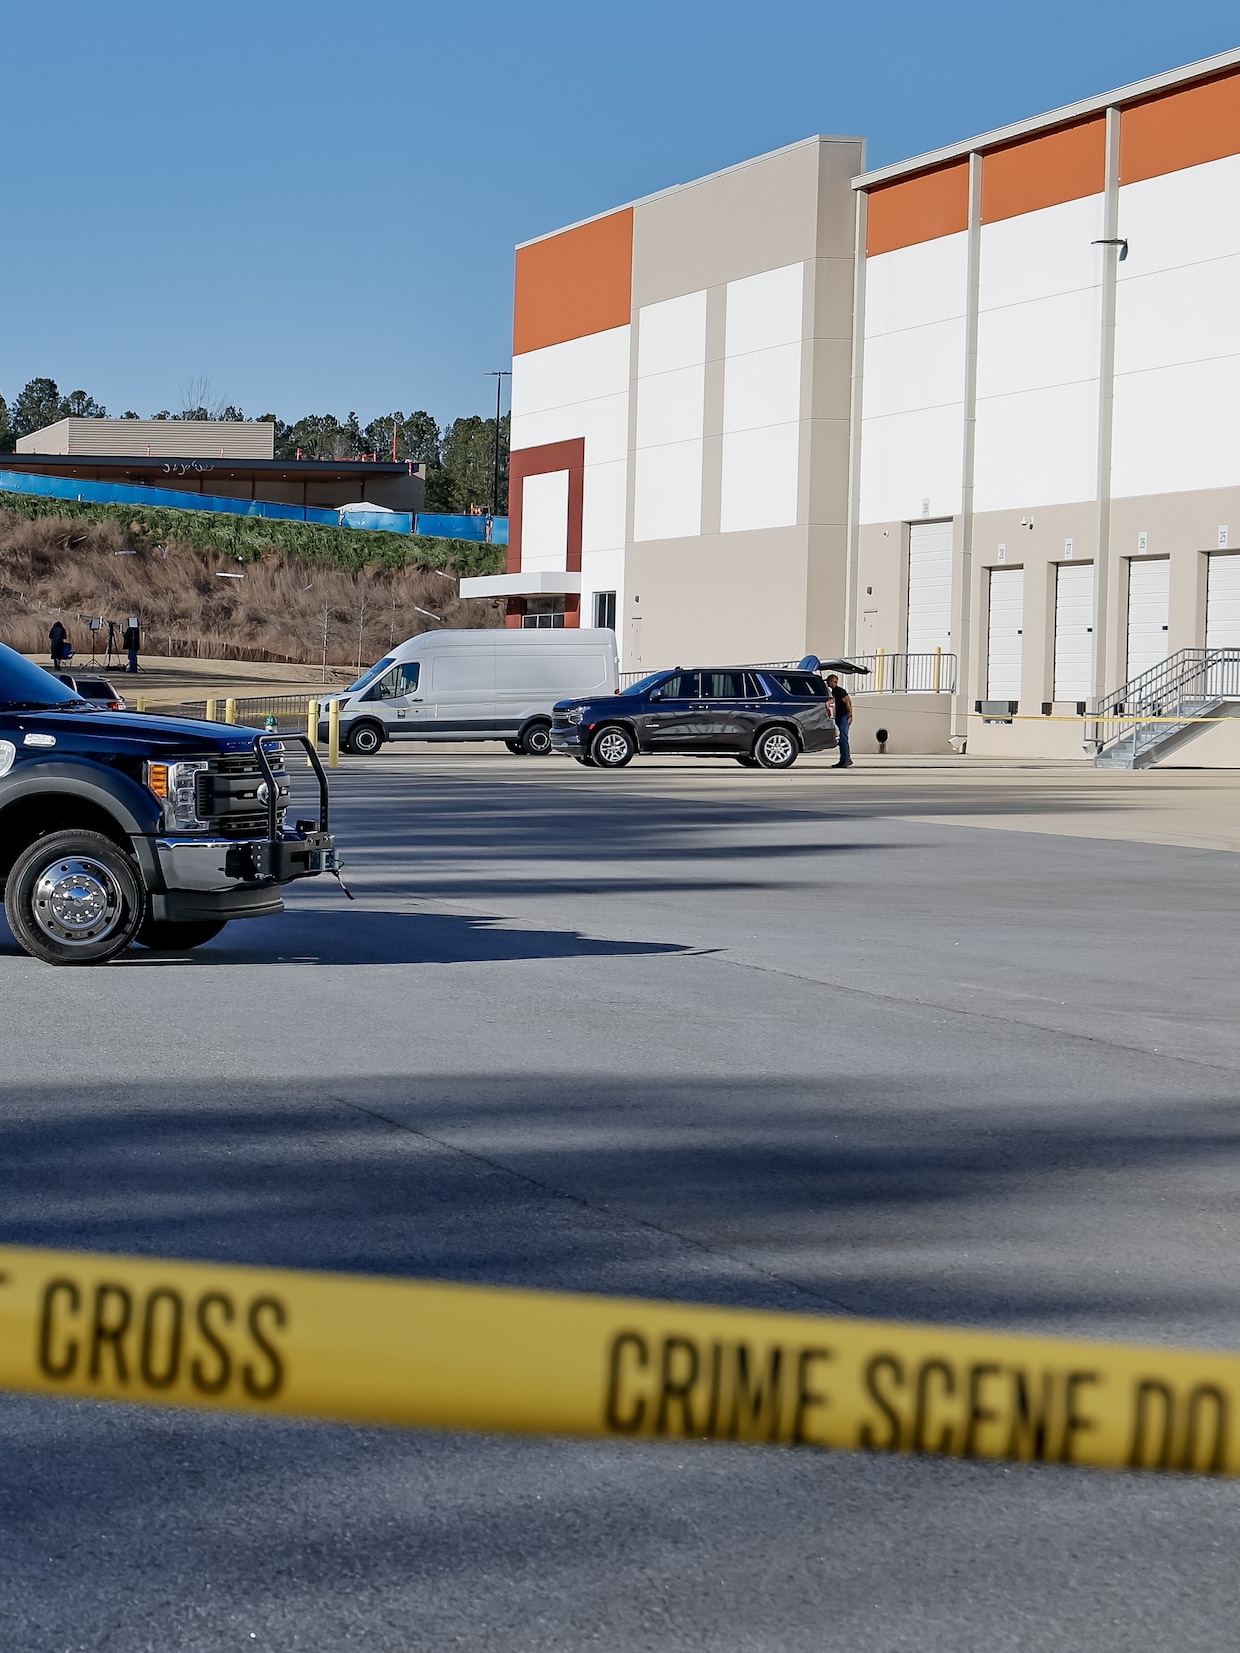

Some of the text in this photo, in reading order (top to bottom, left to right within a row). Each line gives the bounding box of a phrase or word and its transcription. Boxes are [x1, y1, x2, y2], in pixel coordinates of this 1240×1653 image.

[37, 1276, 289, 1401] CROSS
[605, 1328, 1228, 1472] CRIME SCENE DO
